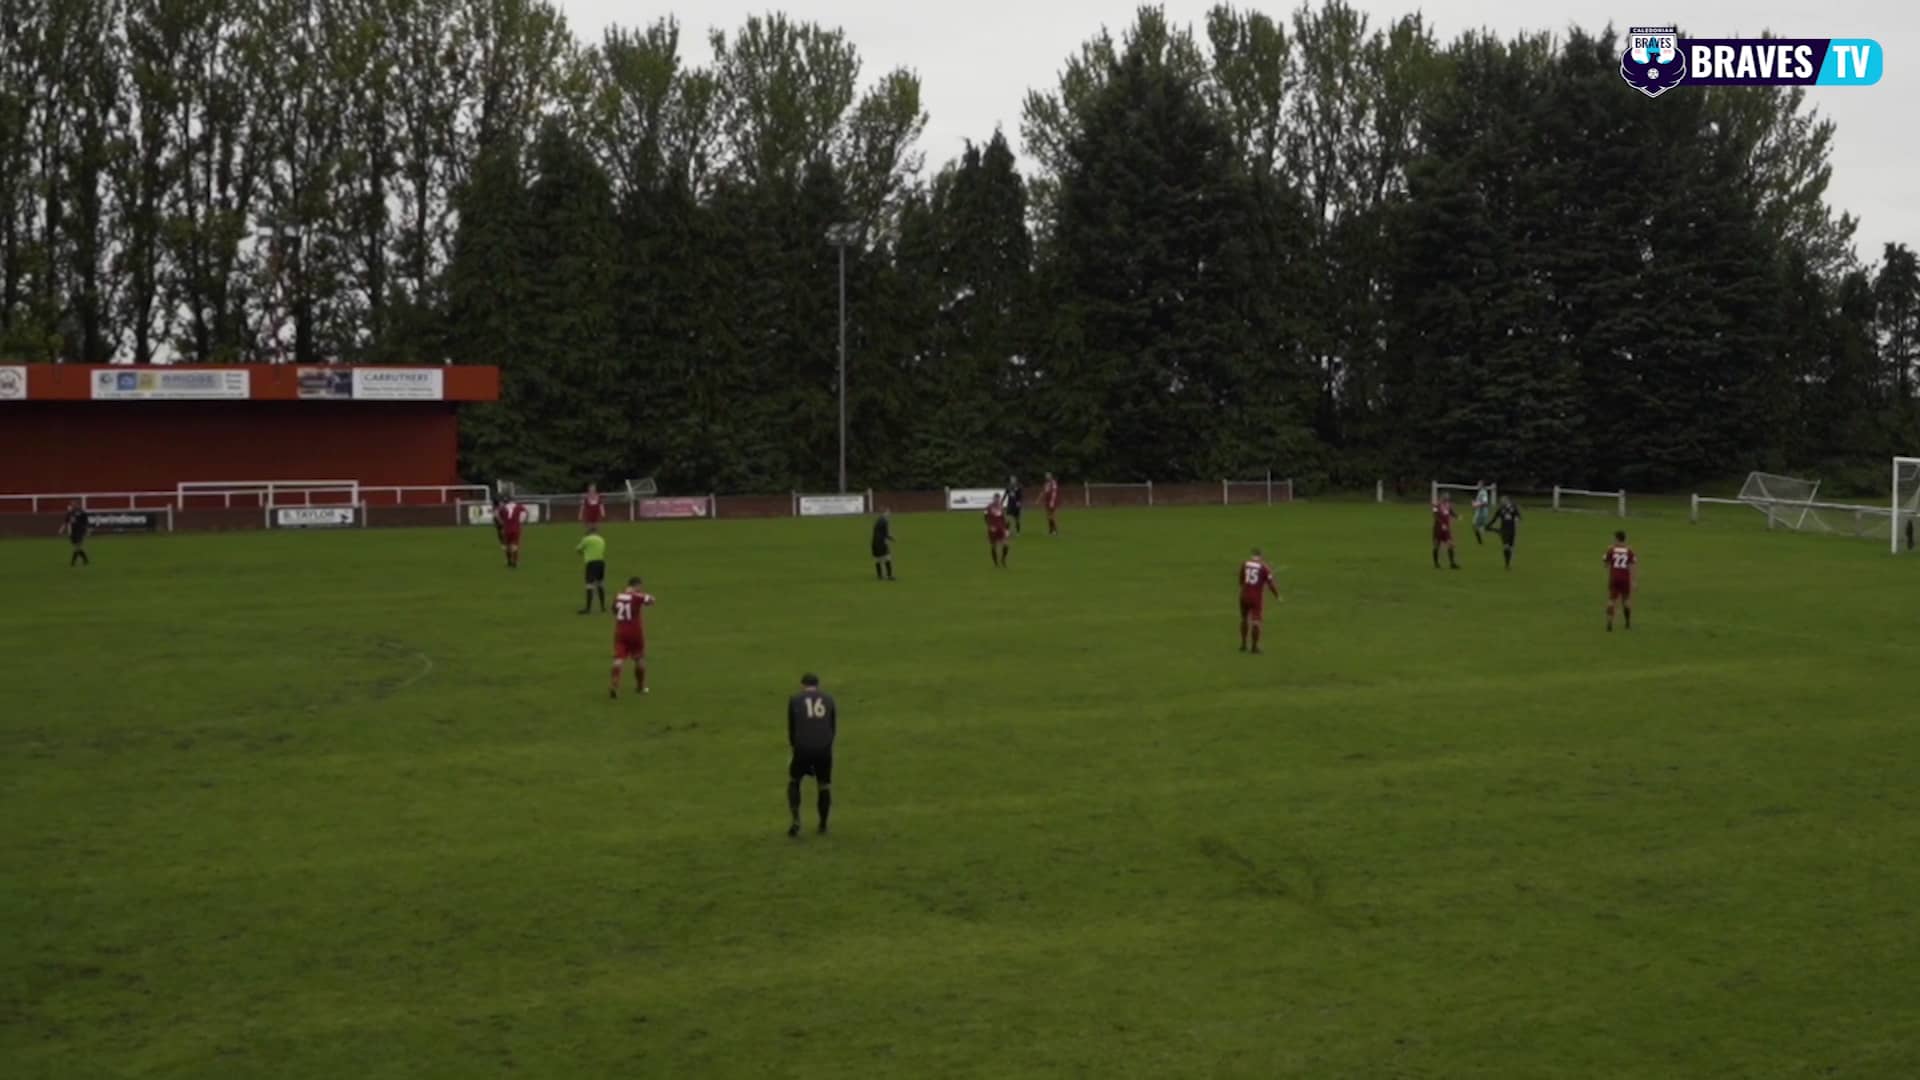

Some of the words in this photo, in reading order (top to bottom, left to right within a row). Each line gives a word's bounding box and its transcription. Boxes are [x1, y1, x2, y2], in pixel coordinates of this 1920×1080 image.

[1612, 553, 1628, 569] 22
[1244, 568, 1259, 585] 15
[615, 601, 632, 620] 21
[805, 697, 826, 718] 16
